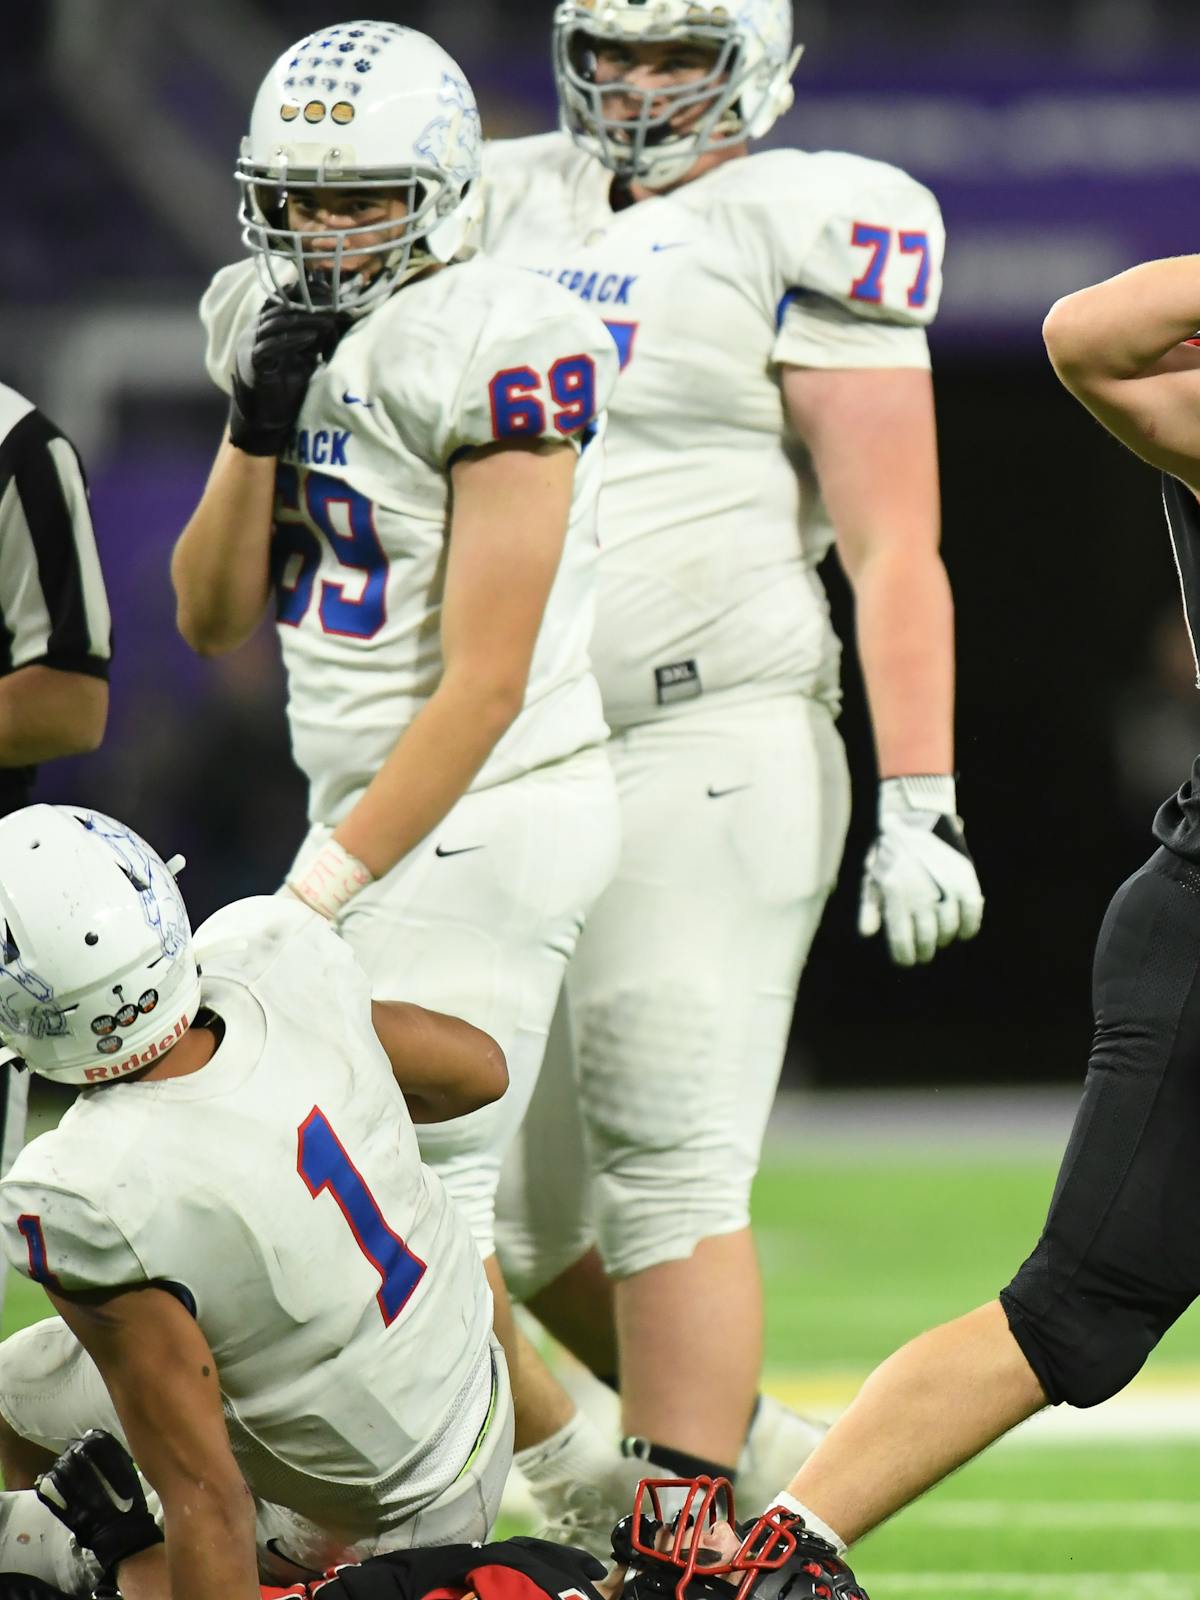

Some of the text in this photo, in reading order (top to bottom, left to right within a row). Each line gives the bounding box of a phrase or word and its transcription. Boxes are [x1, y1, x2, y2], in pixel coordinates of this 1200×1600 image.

[849, 221, 930, 309] 77
[489, 353, 595, 441] 69
[275, 464, 389, 640] 69
[84, 1014, 189, 1080] Riddell
[17, 1214, 60, 1287] 1
[297, 1105, 427, 1328] 1
